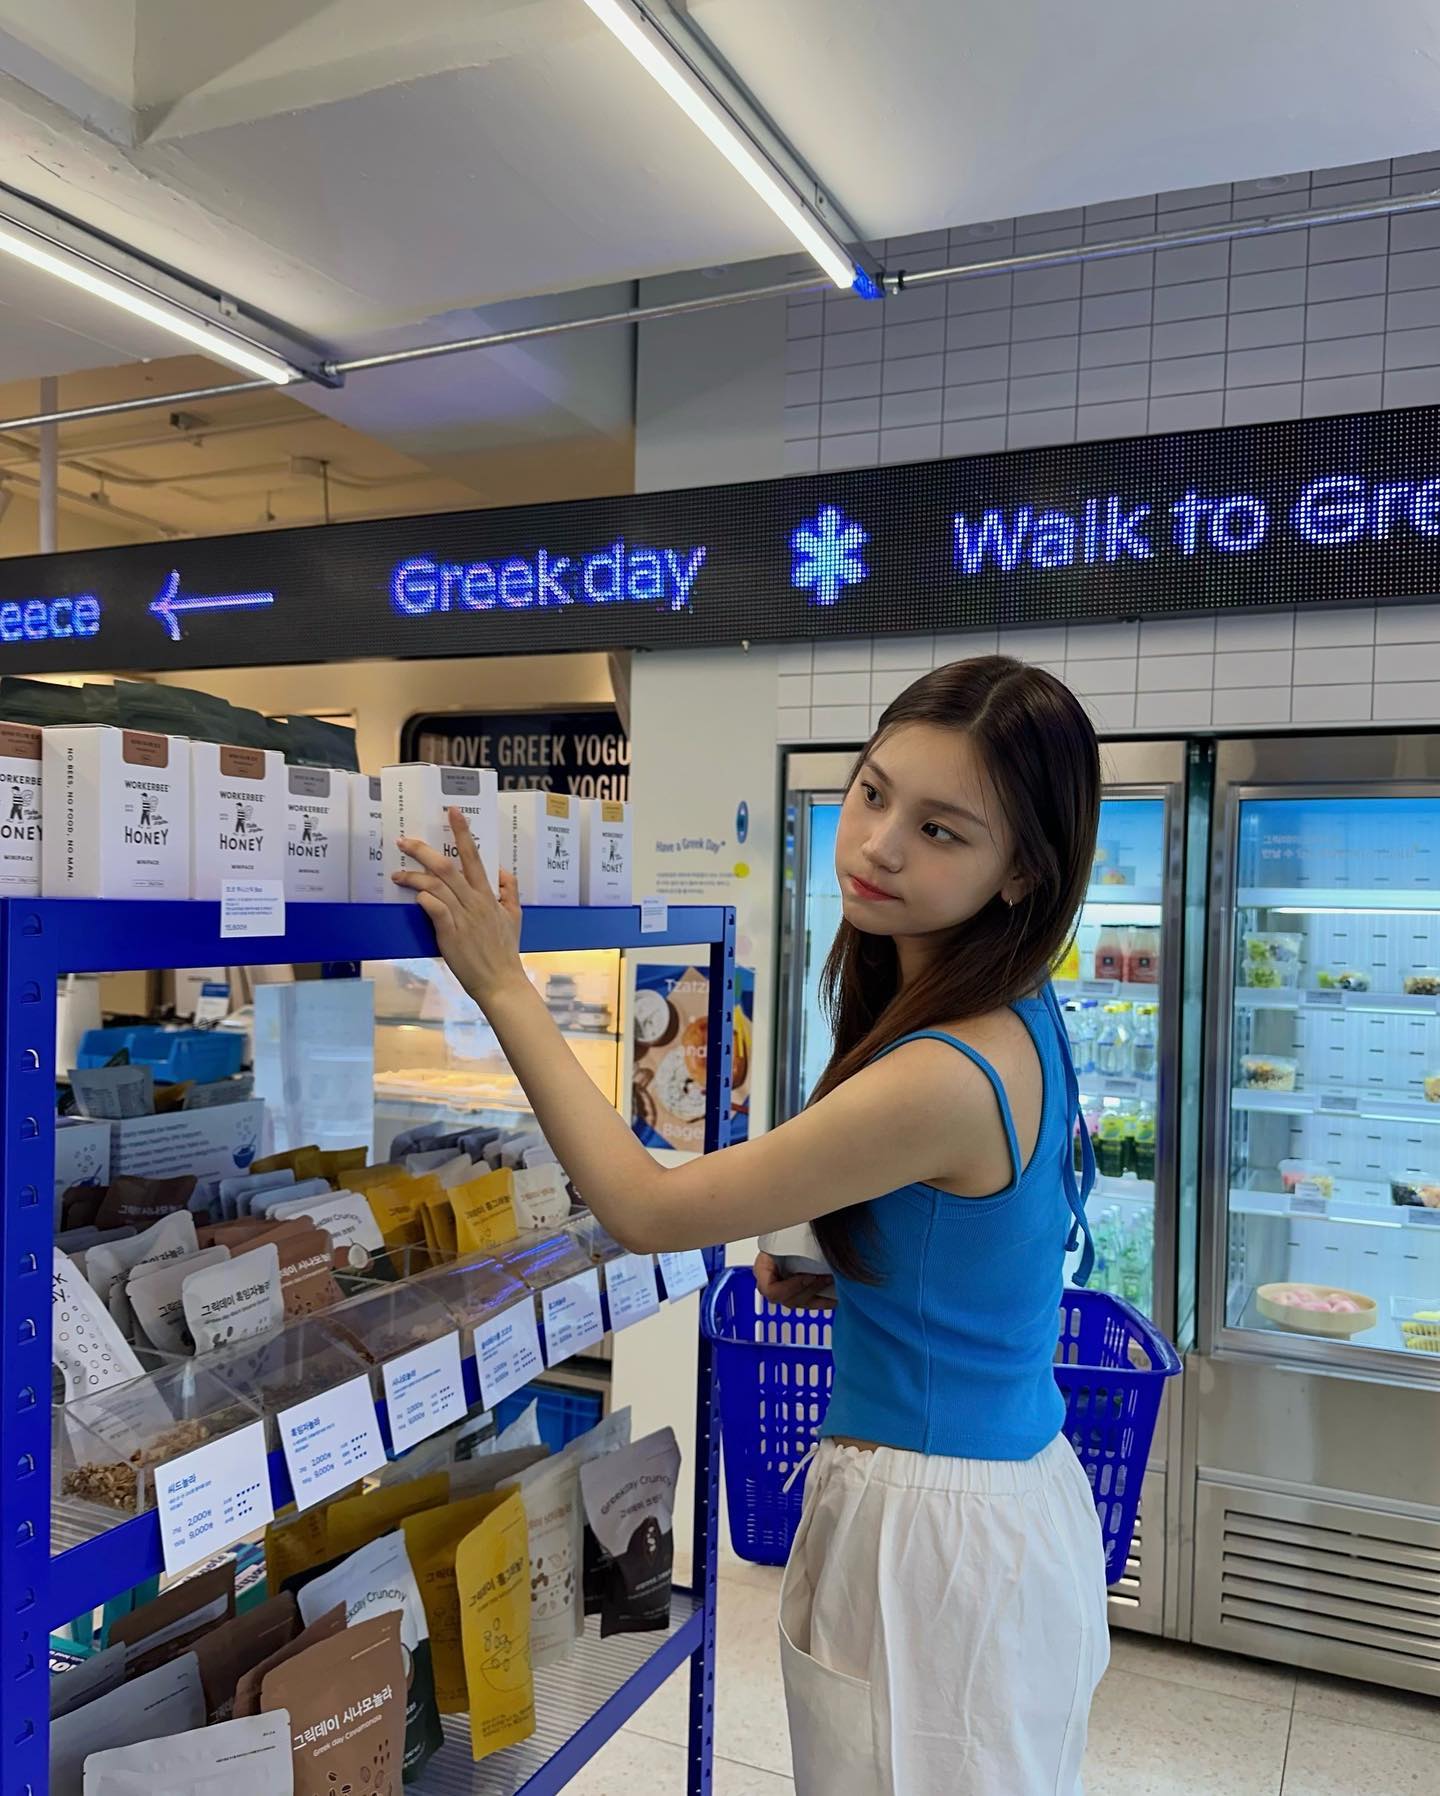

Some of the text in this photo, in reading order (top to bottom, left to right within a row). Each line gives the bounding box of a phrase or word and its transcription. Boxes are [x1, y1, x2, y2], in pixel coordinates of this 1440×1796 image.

[954, 476, 1440, 574] Walk to Gre
[0, 594, 101, 642] eece
[66, 747, 74, 762] NO
[440, 735, 493, 767] LOVE
[498, 734, 567, 767] GREEK
[573, 733, 631, 766] YOGU
[0, 773, 42, 786] ORKERBE
[66, 764, 74, 788] BEES,
[567, 774, 629, 801] YOGU
[66, 791, 74, 806] NO
[66, 808, 74, 837] FOOD,
[0, 824, 42, 841] ONEY
[124, 825, 169, 846] HONEY
[66, 839, 74, 854] NO
[219, 833, 264, 852] HONEY
[288, 840, 329, 858] HONEY
[547, 857, 570, 871] HONEY
[601, 861, 623, 874] HONEY
[664, 978, 711, 994] Tzatzi
[662, 1122, 705, 1140] Bage
[200, 1294, 236, 1317] 그릭데이
[366, 1588, 408, 1603] Crunchy
[293, 1713, 340, 1751] 그릭데이
[342, 1683, 393, 1724] 시나모놀라
